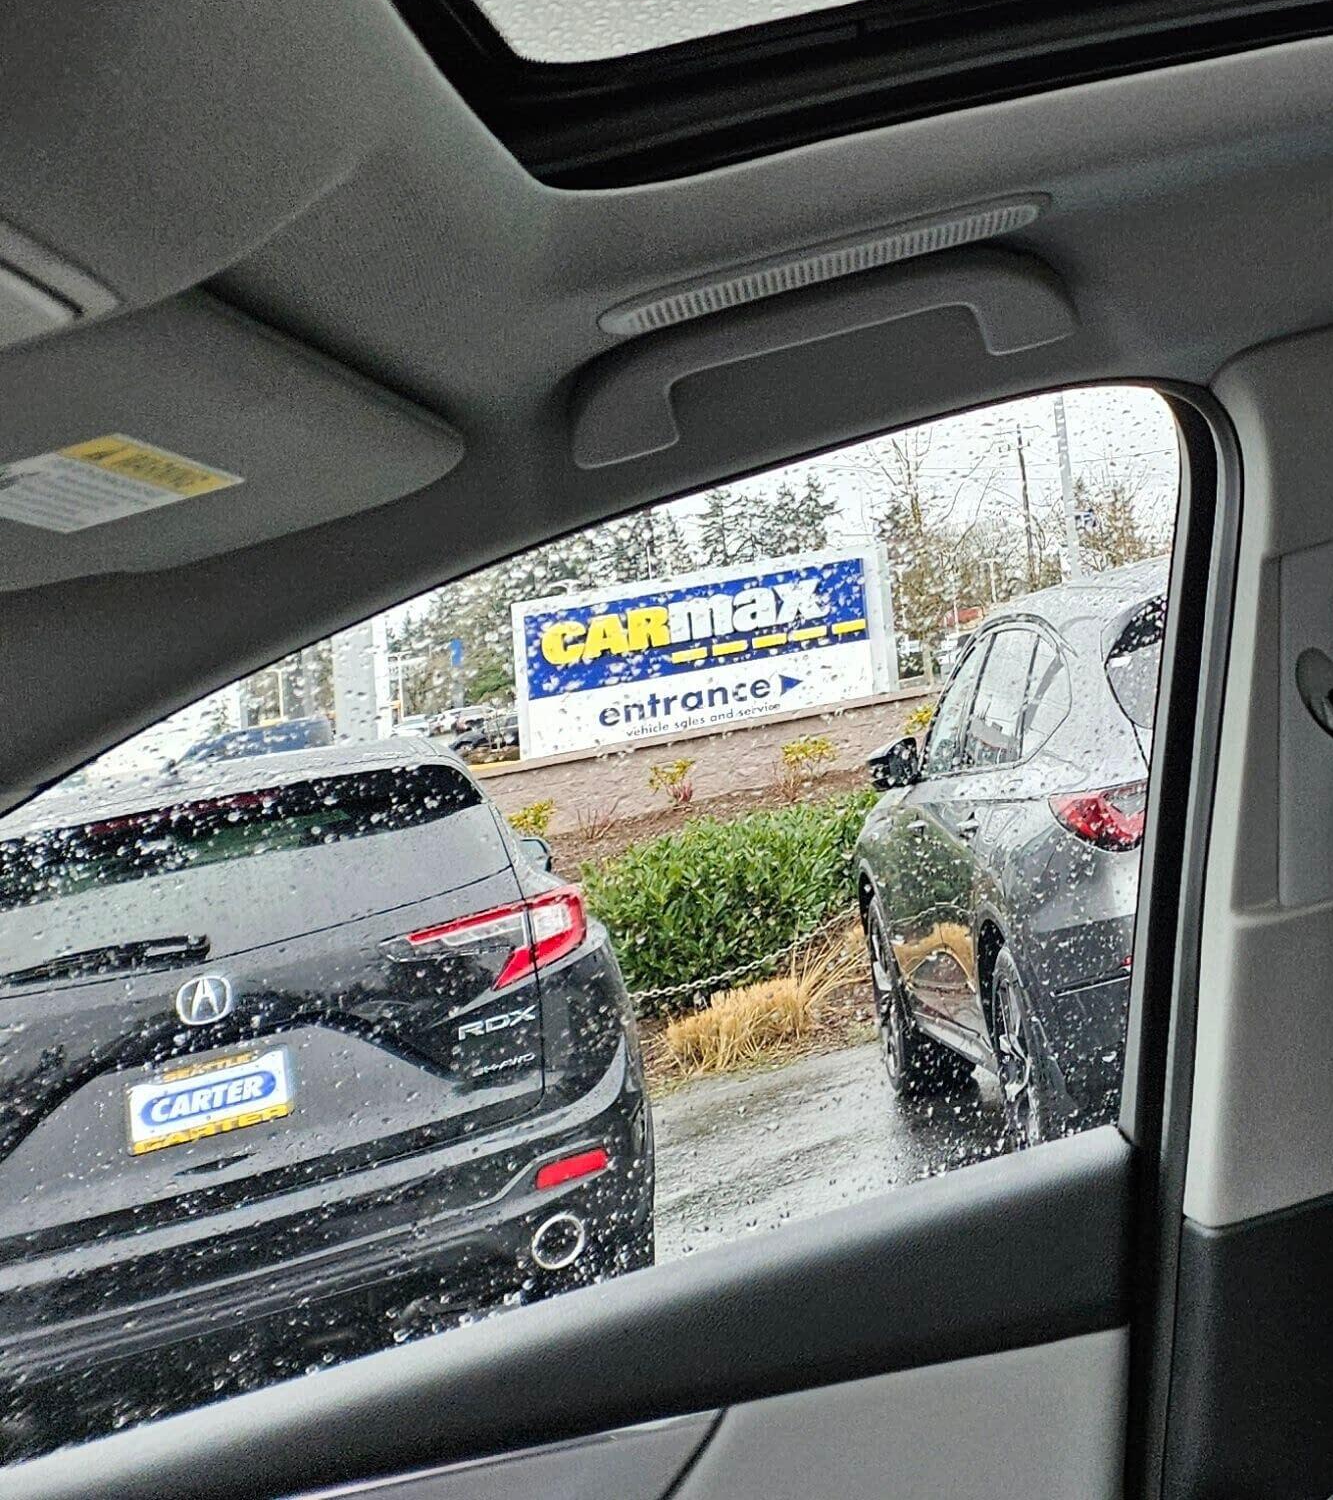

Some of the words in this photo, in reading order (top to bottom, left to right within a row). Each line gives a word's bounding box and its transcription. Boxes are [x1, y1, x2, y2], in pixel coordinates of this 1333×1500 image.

[541, 578, 829, 666] CARmax
[598, 675, 771, 727] entrance
[626, 721, 669, 737] vehicle
[674, 716, 706, 729] sales
[710, 708, 735, 722] and
[738, 702, 781, 717] service
[458, 1004, 536, 1041] RDX
[150, 1074, 263, 1123] CARTER
